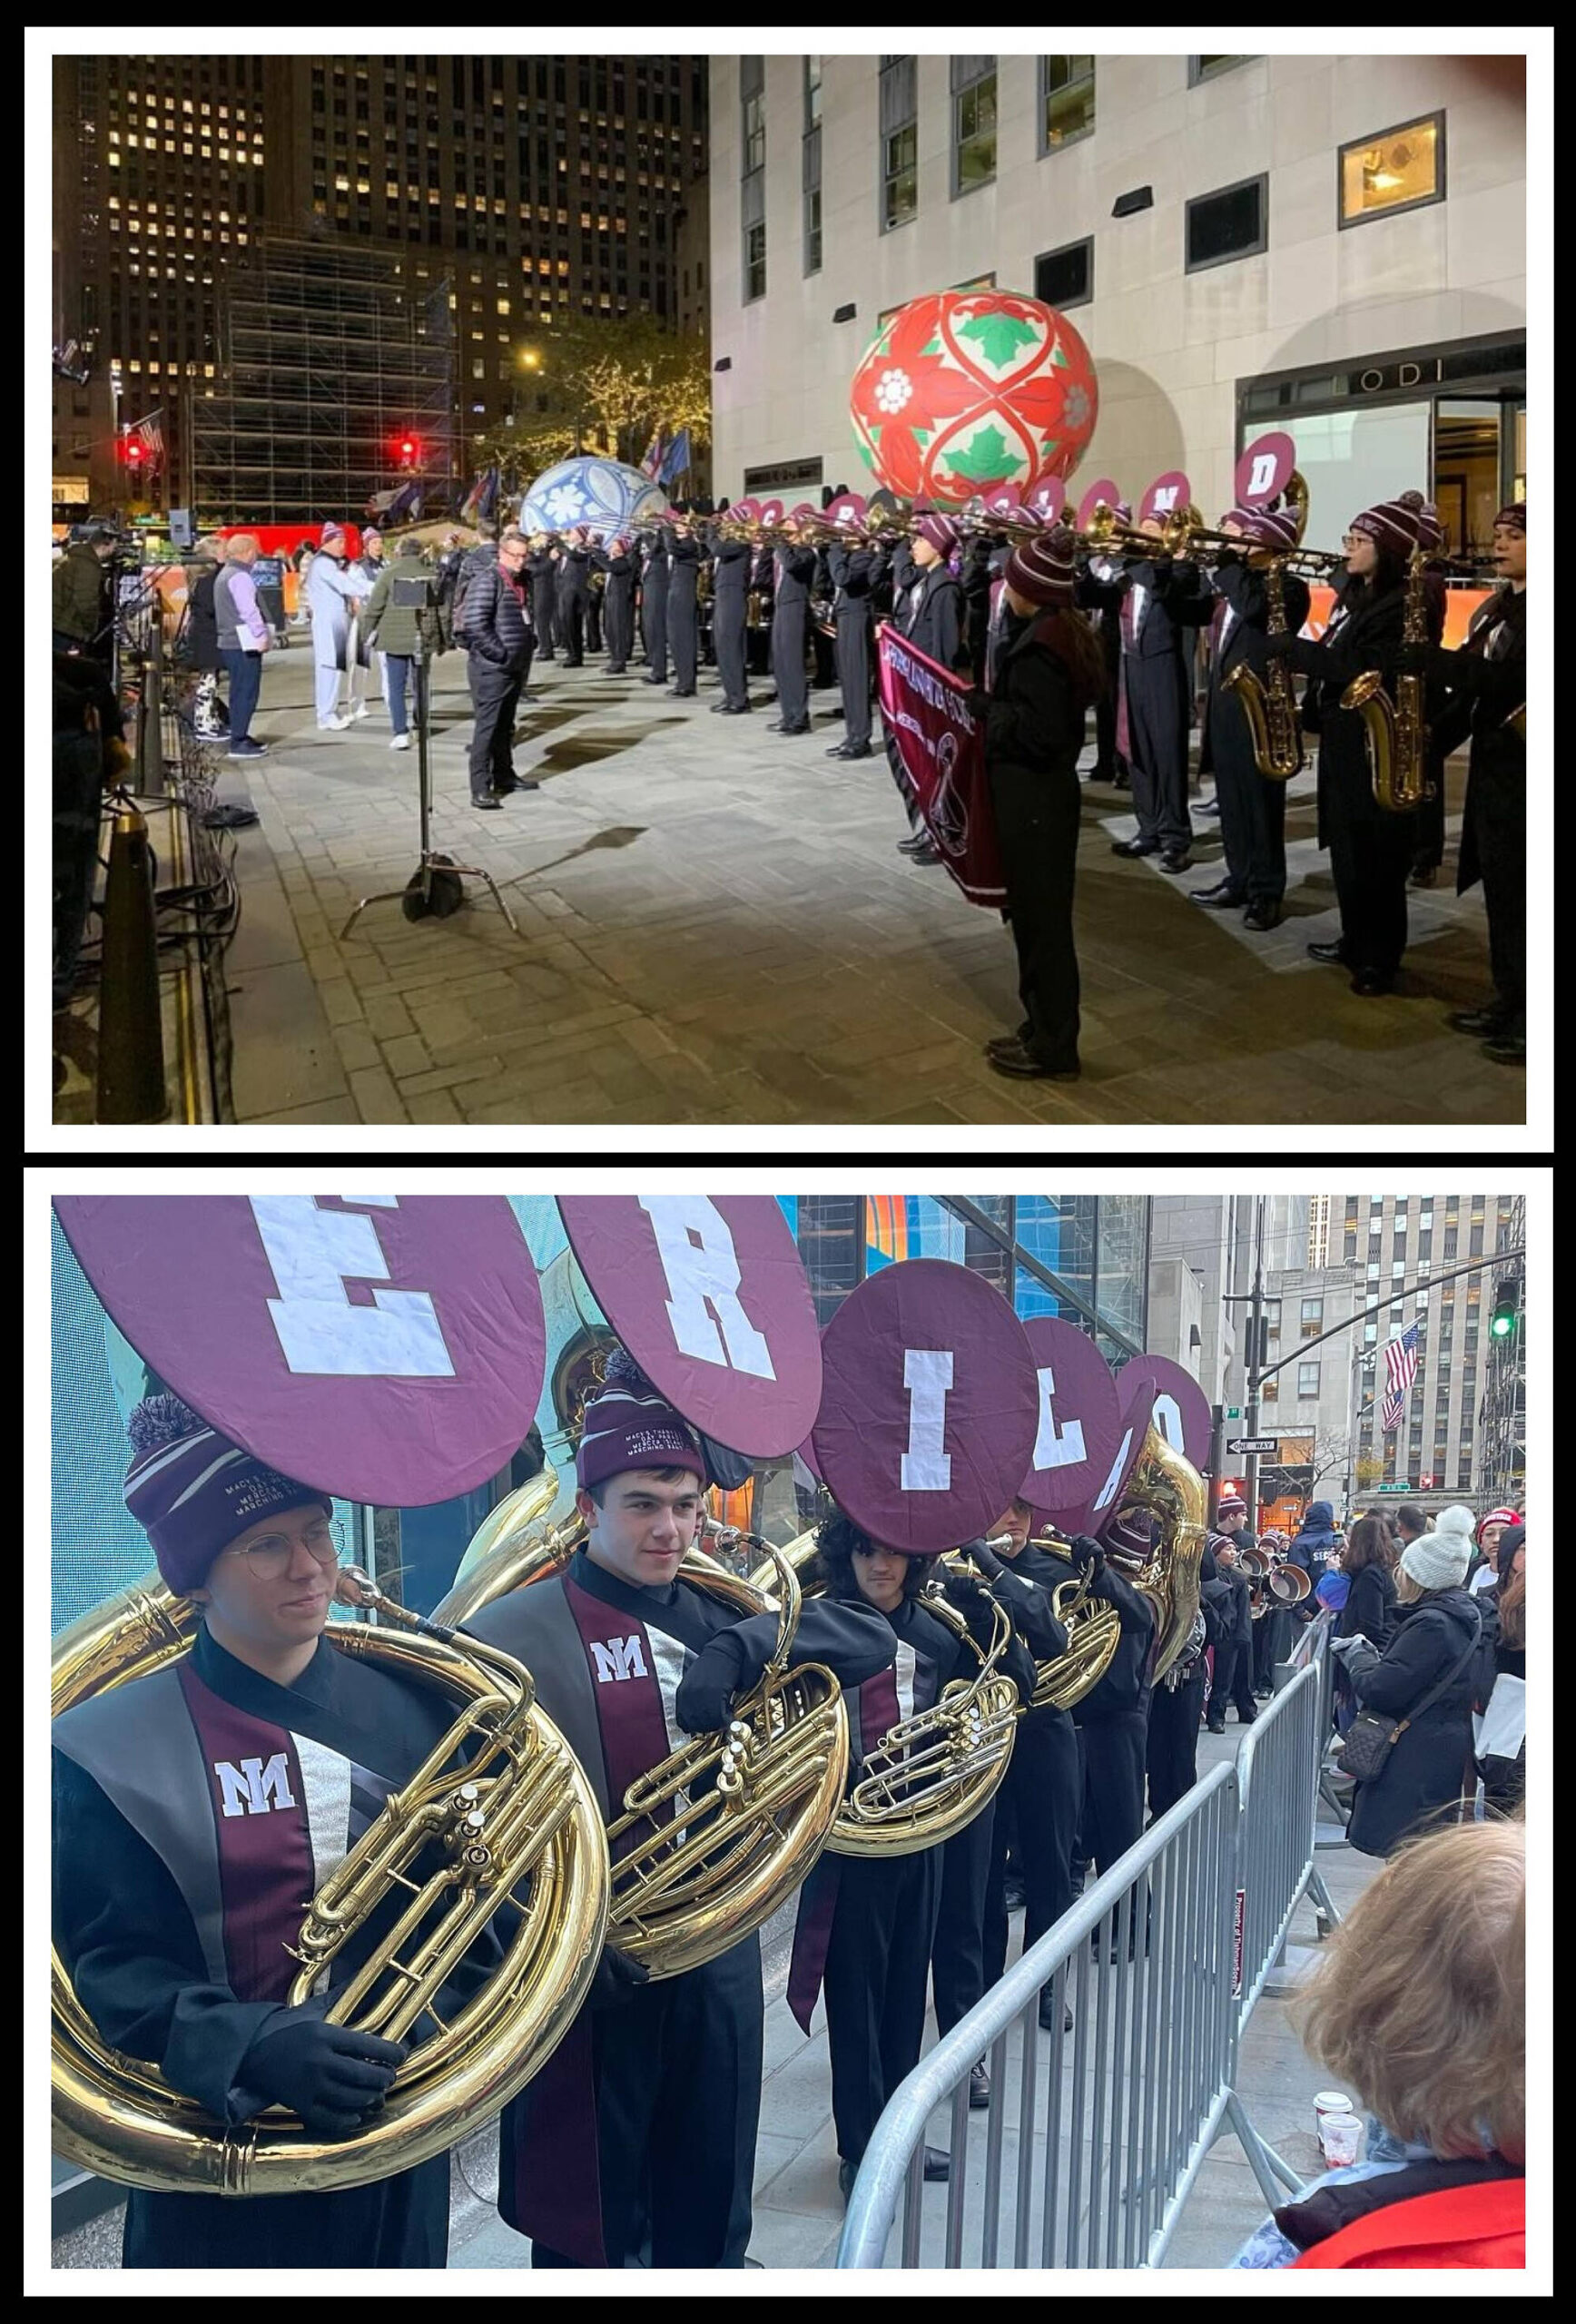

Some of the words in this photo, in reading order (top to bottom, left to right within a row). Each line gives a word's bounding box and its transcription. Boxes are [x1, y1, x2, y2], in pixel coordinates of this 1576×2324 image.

[1247, 453, 1278, 497] D
[251, 1195, 456, 1376] E
[637, 1195, 777, 1382] R
[900, 1348, 954, 1492] I
[1032, 1366, 1088, 1472] L
